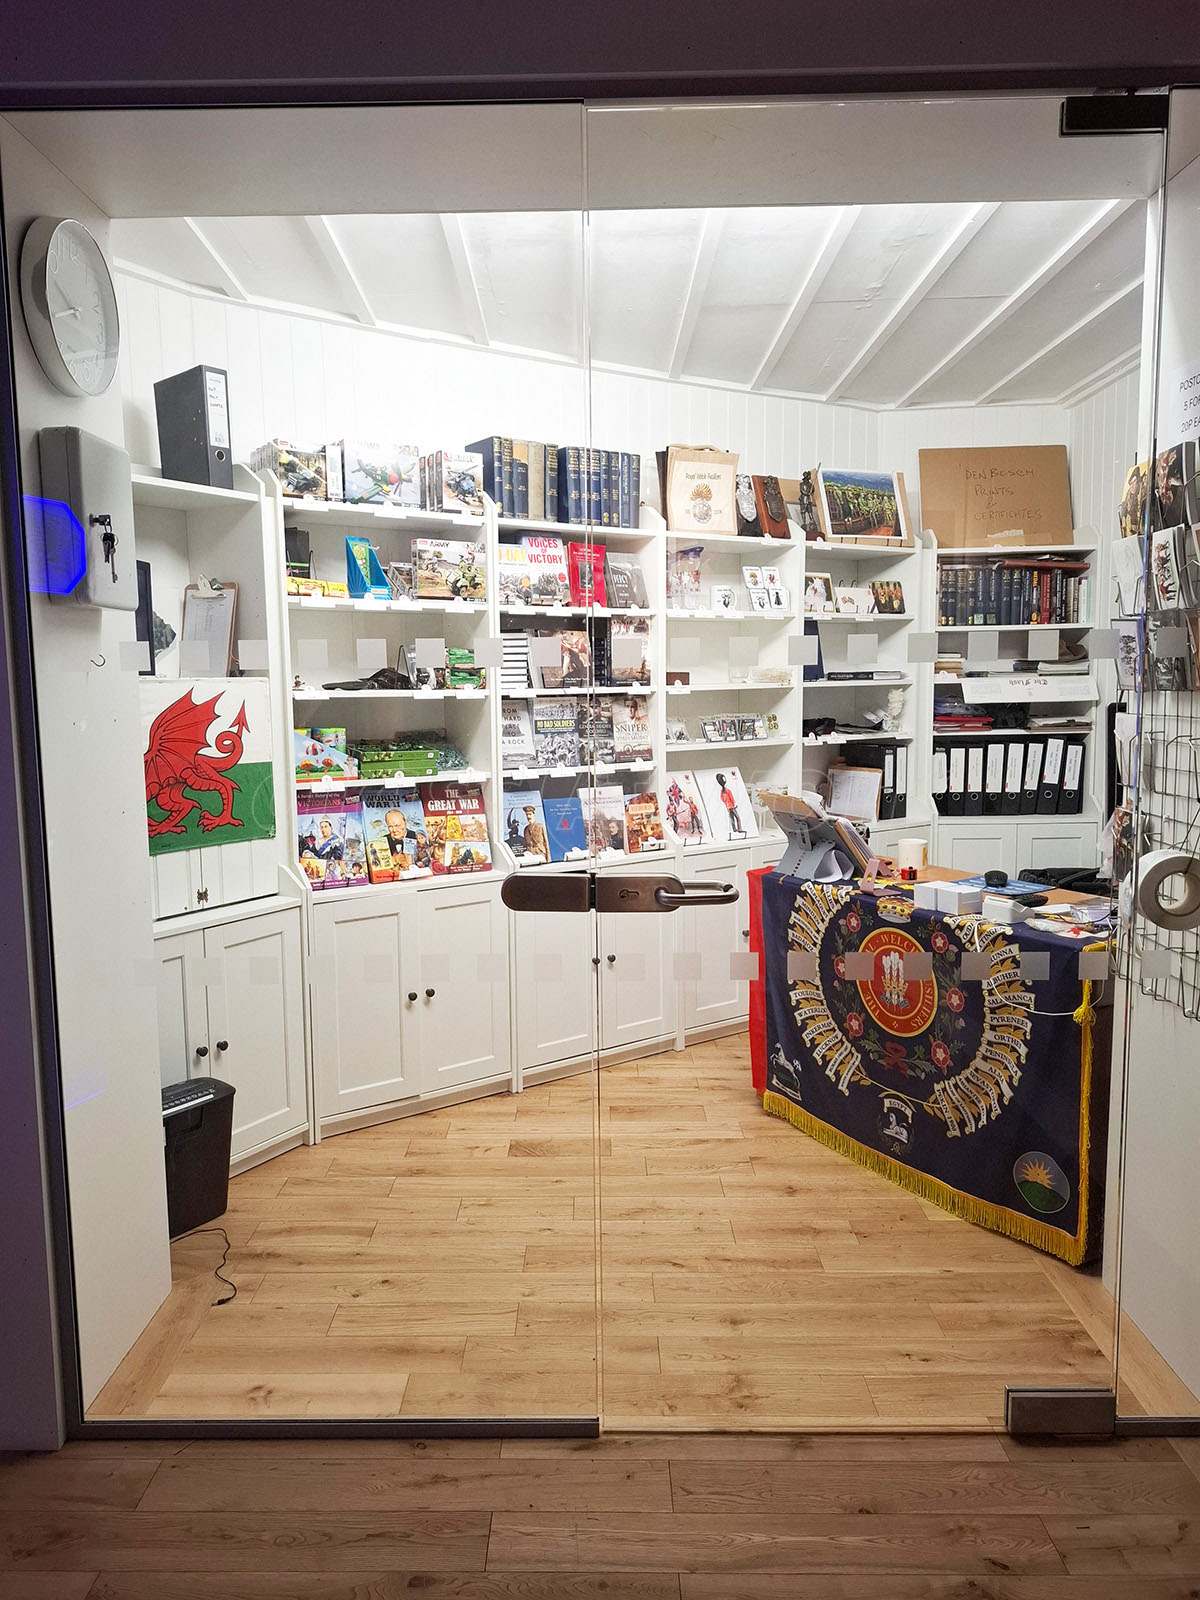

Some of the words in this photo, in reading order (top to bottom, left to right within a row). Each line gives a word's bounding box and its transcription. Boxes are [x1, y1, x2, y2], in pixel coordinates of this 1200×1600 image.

[1183, 400, 1188, 411] 5
[965, 468, 987, 481] DEN
[990, 467, 1034, 479] BOSCH
[974, 484, 1015, 497] PRINTS
[528, 538, 558, 549] VOICES
[527, 554, 563, 564] VICTORY
[616, 723, 647, 732] SNIPER
[367, 794, 400, 802] WORLD
[445, 789, 460, 798] THE
[297, 799, 341, 807] VICTORIANS
[364, 801, 390, 809] WAR
[428, 799, 456, 811] GREAT
[458, 798, 480, 810] WAR
[801, 901, 821, 925] MINDEN
[986, 971, 1020, 988] ALBUHER
[911, 980, 934, 1030] SILIERS
[990, 1016, 1029, 1028] PYRENEES
[804, 1021, 833, 1039] INKERMAN
[815, 1034, 839, 1057] LUCKNOW
[984, 1047, 1018, 1077] PENINSULA
[968, 1070, 999, 1112] SEVASTOPOL
[888, 1100, 908, 1112] EGYPT
[936, 1089, 949, 1114] PEKIN
[947, 1115, 958, 1132] 1900
